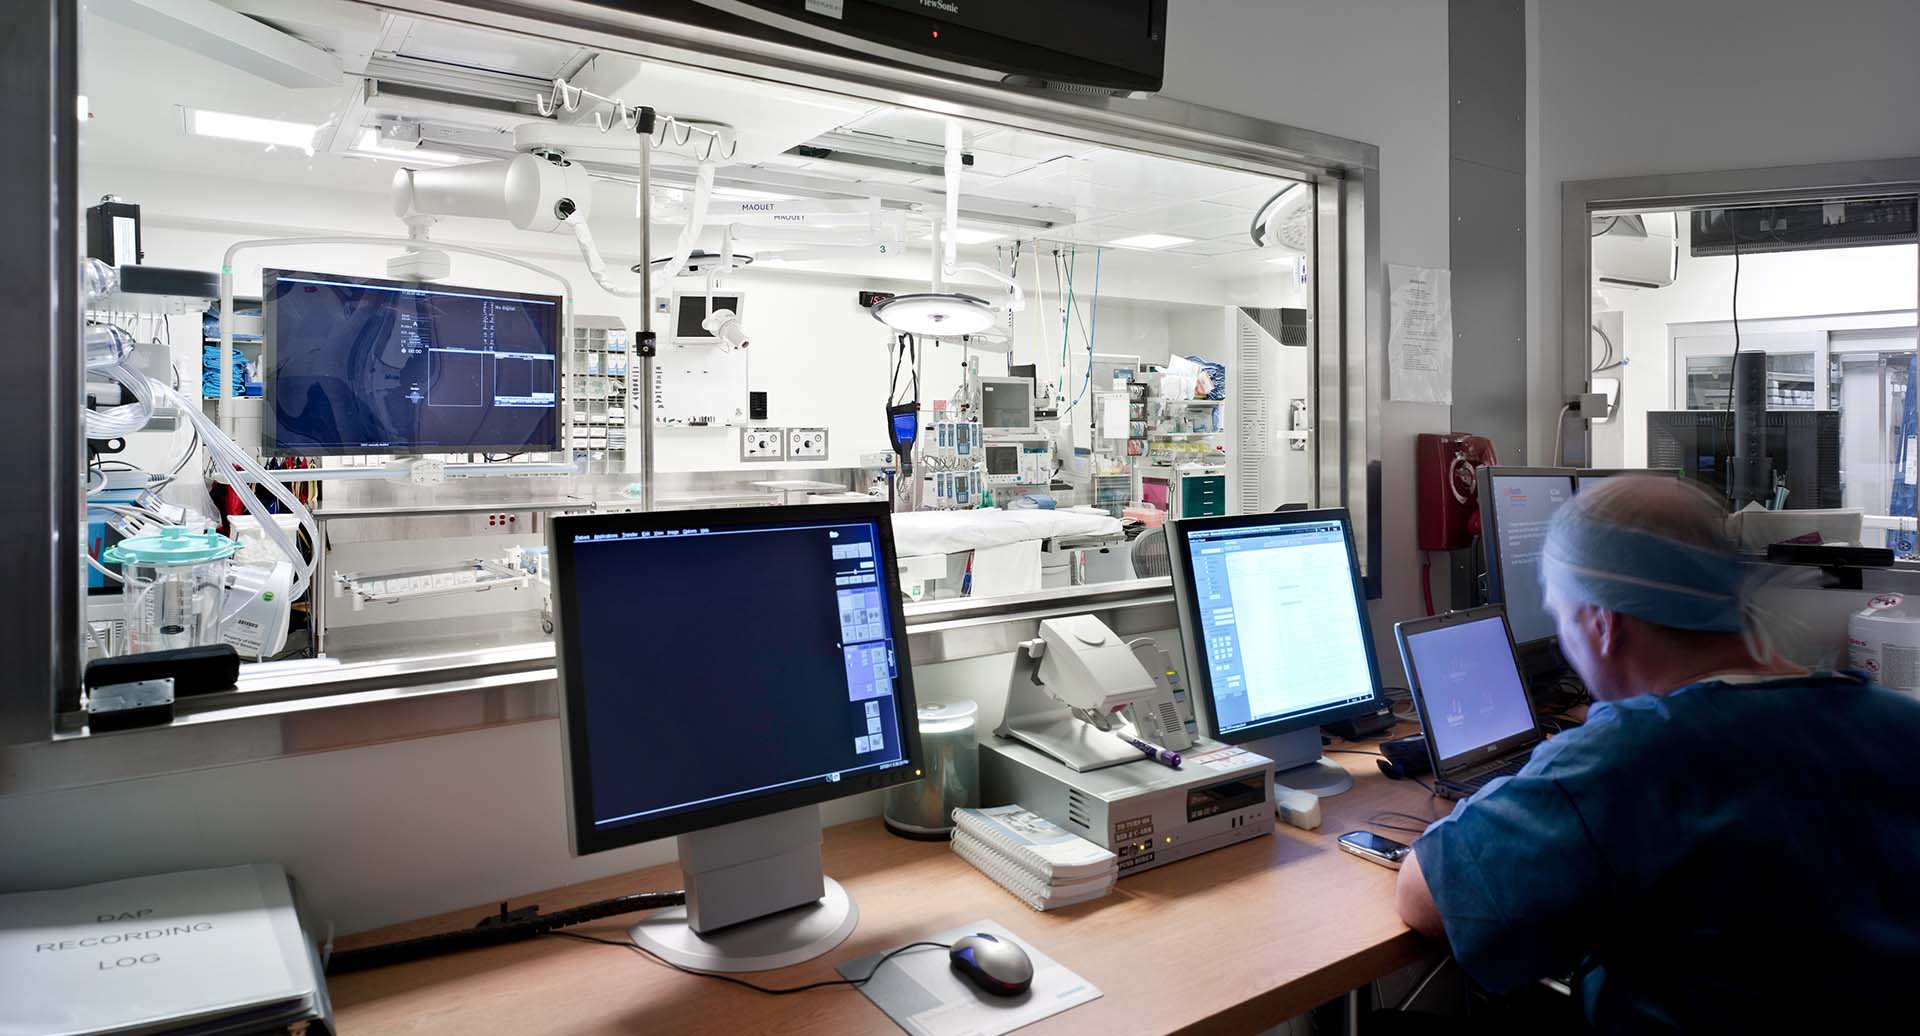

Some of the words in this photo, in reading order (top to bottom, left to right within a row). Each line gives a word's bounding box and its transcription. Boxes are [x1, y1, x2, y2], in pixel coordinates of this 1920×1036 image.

[879, 245, 887, 253] 3
[96, 908, 153, 923] DAP
[36, 921, 213, 953] RECORDING
[98, 953, 161, 971] LOG
